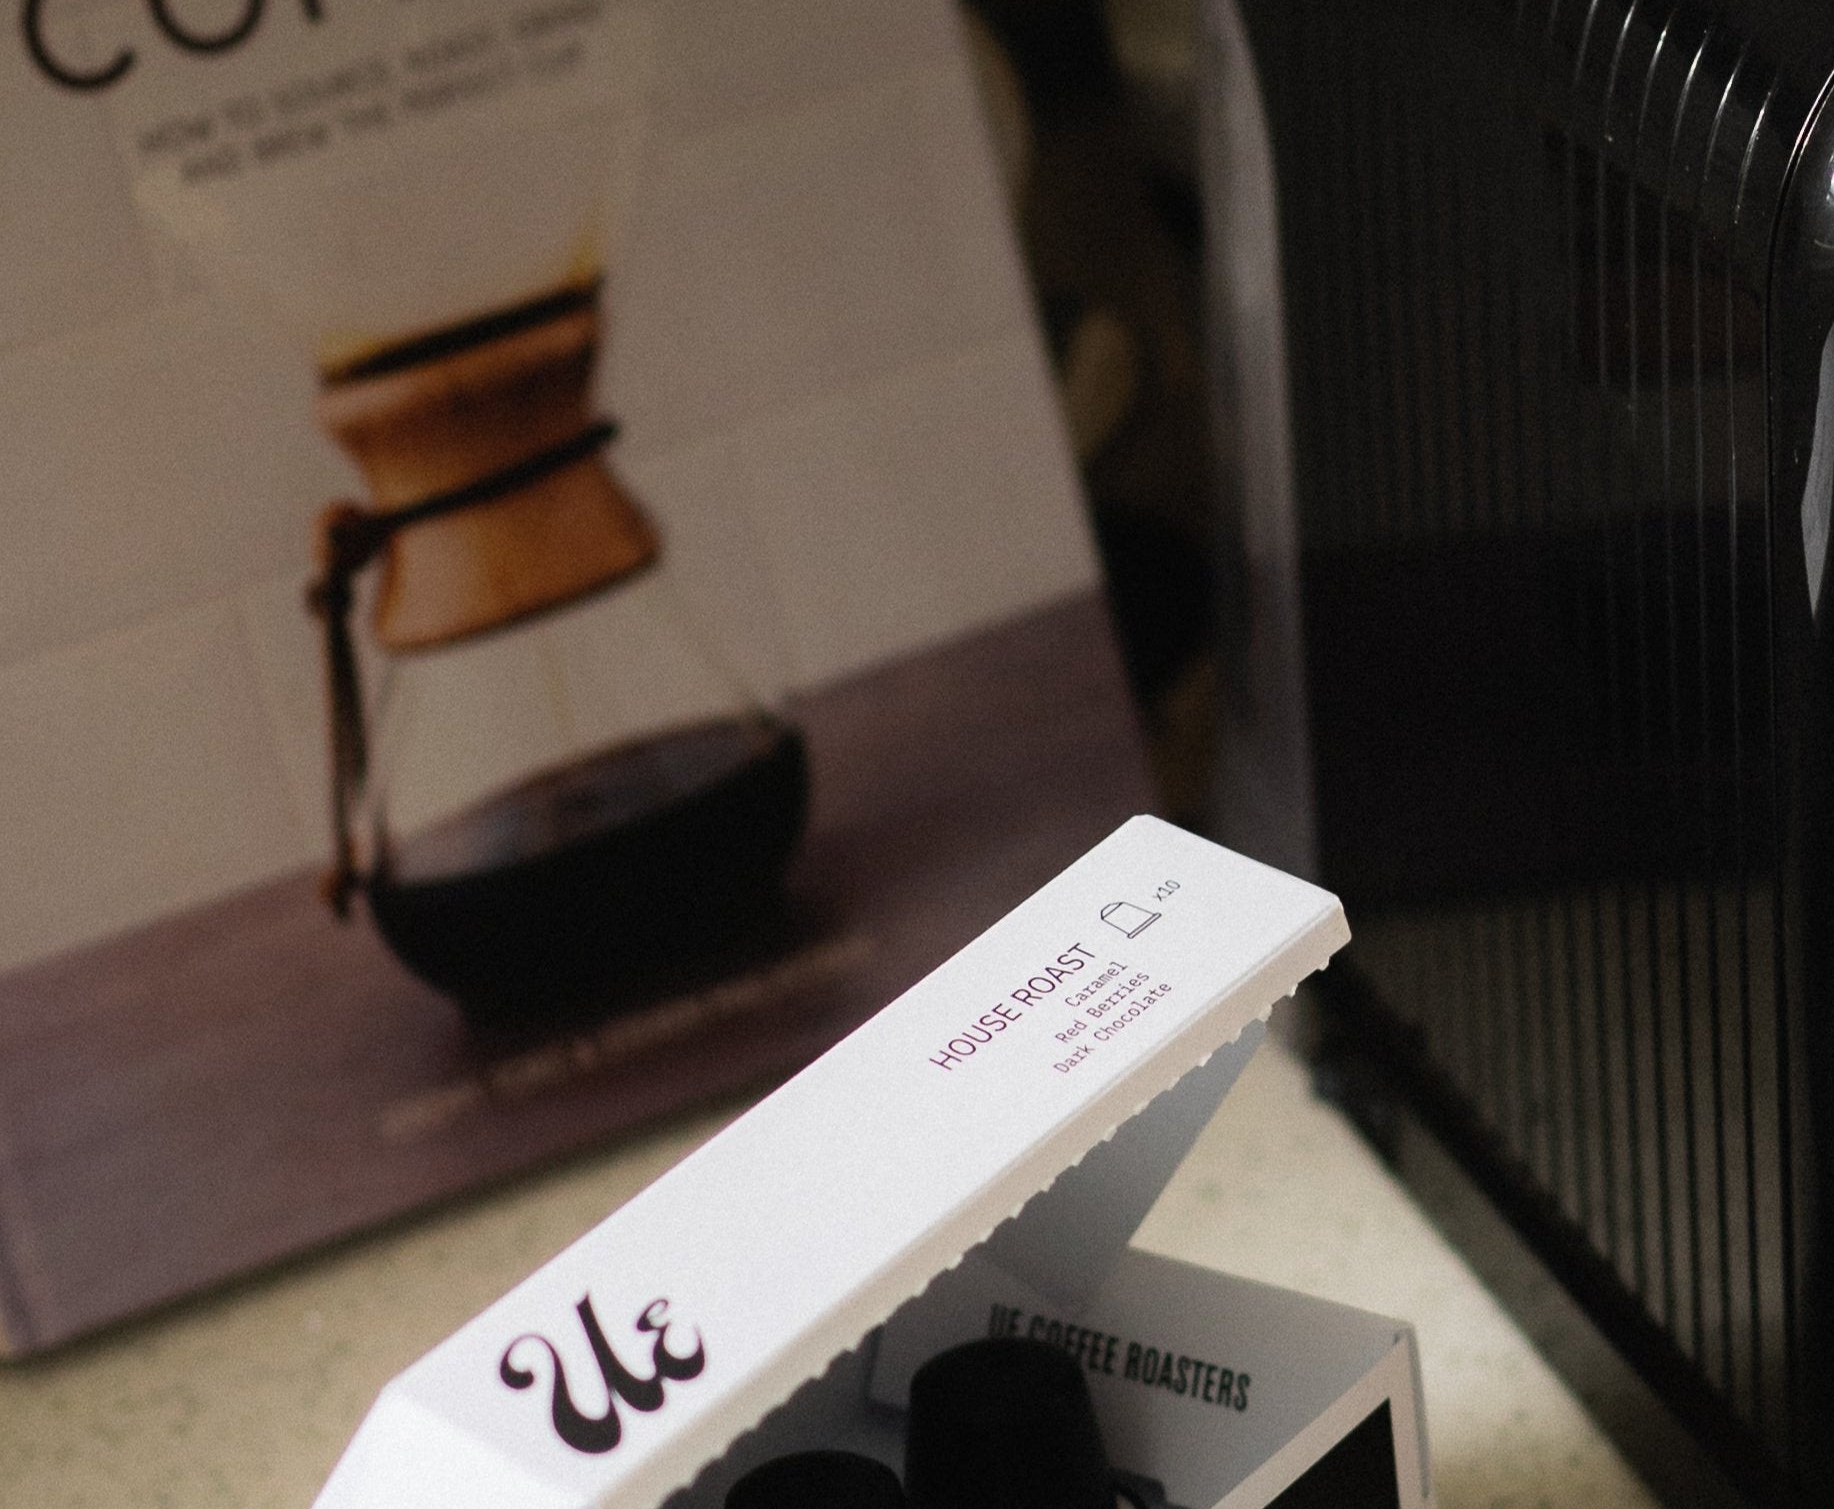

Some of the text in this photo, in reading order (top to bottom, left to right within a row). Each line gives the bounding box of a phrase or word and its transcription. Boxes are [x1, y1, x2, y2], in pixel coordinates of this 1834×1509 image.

[1152, 878, 1181, 903] x10
[929, 942, 1096, 1071] HOUSE ROAST
[1055, 971, 1150, 1044] Red Berries
[1064, 960, 1129, 1008] Caramel
[1053, 981, 1172, 1074] Dark Chocolate
[1123, 1341, 1252, 1412] ROASTERS
